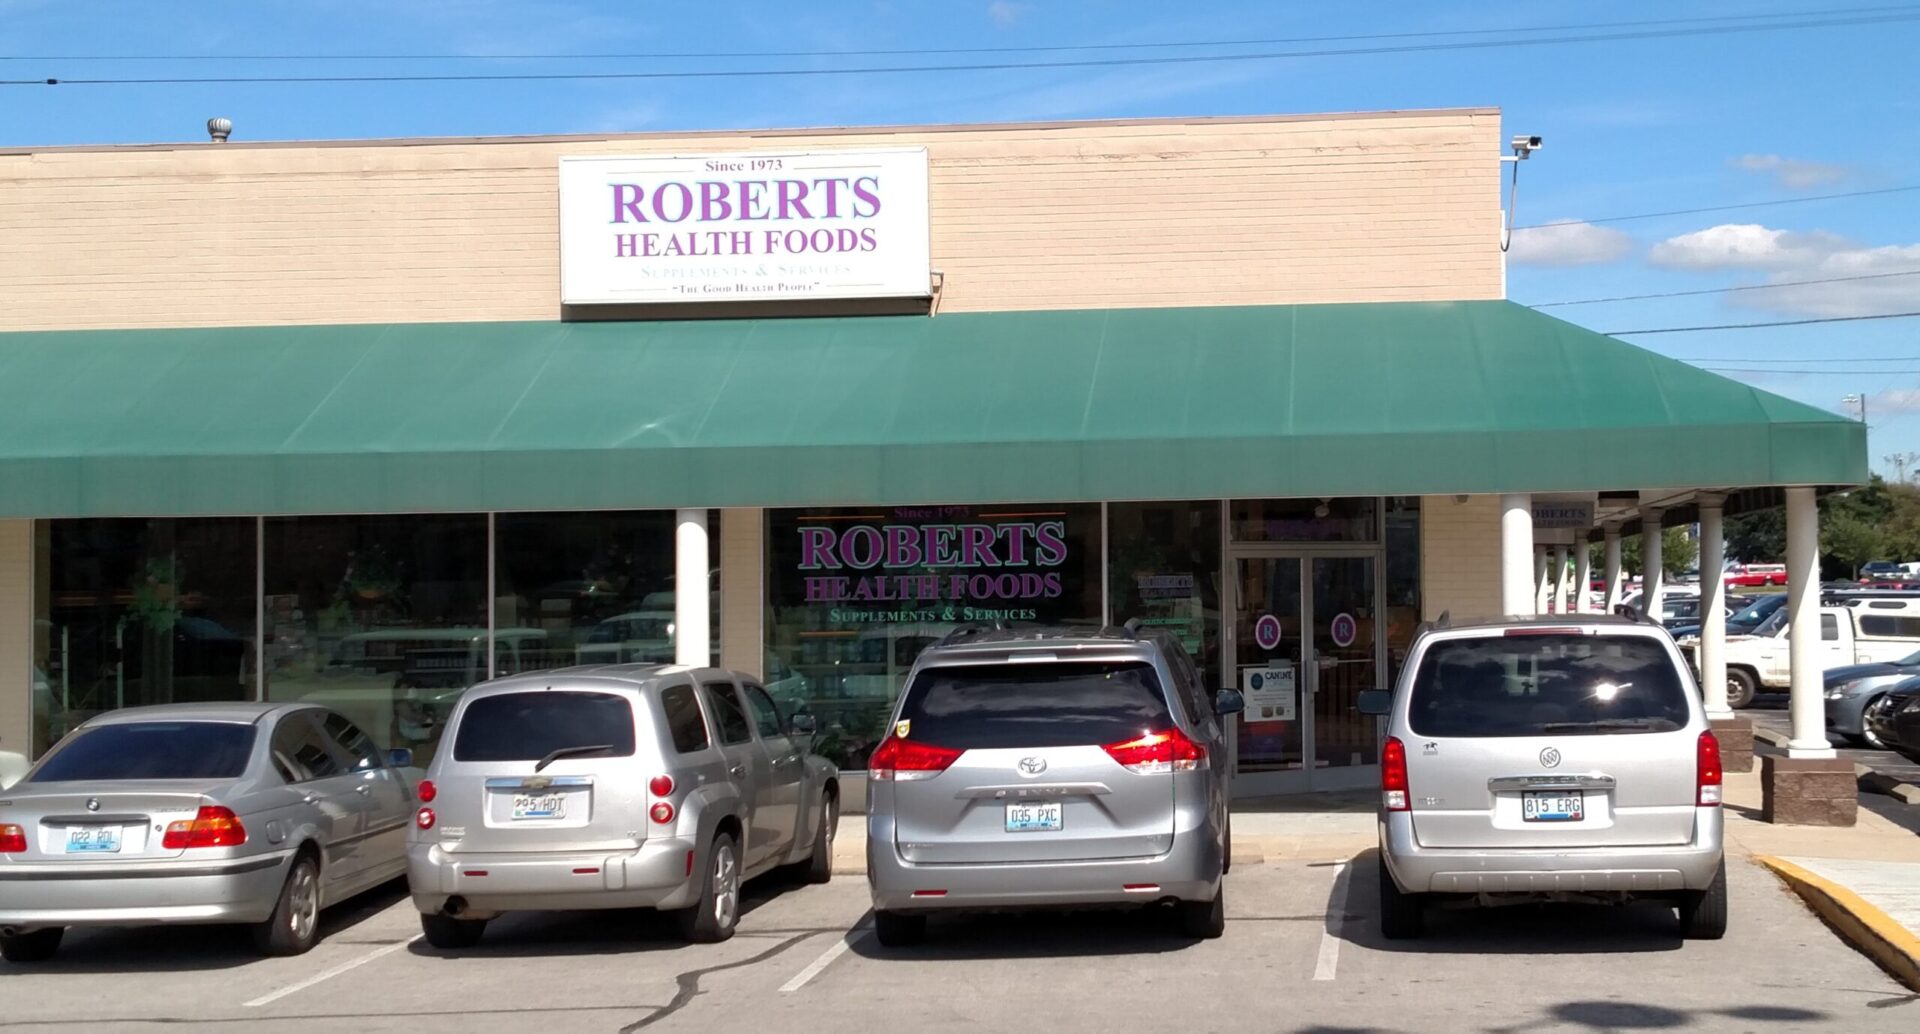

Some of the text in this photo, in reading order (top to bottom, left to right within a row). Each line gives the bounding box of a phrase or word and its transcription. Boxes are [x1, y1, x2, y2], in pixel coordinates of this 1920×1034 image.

[705, 159, 783, 172] Since 1973
[608, 176, 882, 224] ROBERTS
[614, 227, 878, 258] HEALTH FOODS
[755, 264, 769, 277] &
[894, 507, 932, 519] Since
[797, 521, 1068, 570] ROBERTS
[803, 572, 1063, 602] HEALTH FOODS
[830, 606, 1037, 623] SUPPLEMENTS & SERVICES
[1263, 624, 1274, 640] R
[1339, 622, 1350, 638] R
[1526, 799, 1581, 813] 815 ERG
[1011, 808, 1057, 823] 035 PXC
[71, 831, 90, 845] 022
